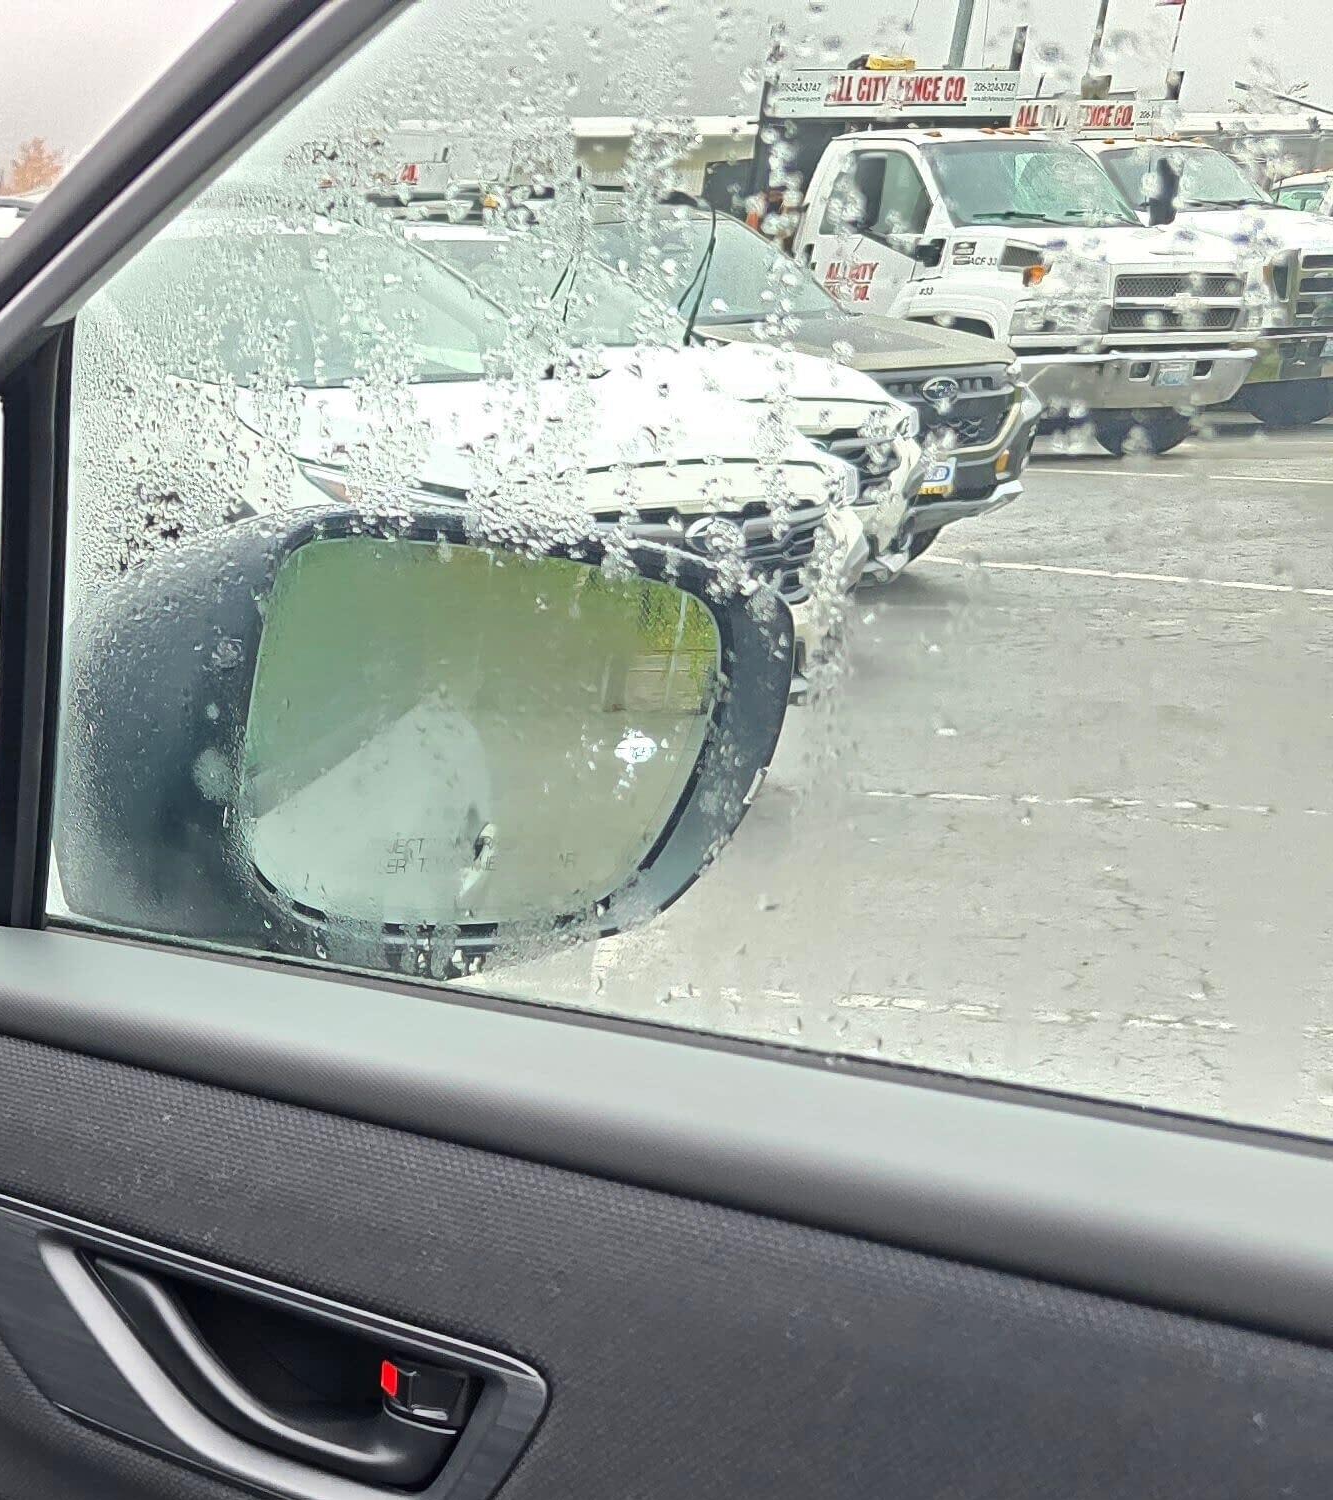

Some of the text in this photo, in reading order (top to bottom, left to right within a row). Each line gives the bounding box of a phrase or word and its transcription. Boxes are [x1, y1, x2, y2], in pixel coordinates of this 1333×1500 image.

[856, 75, 892, 102] CITY
[897, 75, 942, 102] FENCE
[944, 75, 968, 102] CO.
[973, 82, 1016, 93] 206-324-3747
[1016, 105, 1039, 127] ALL
[1114, 105, 1134, 127] CO.
